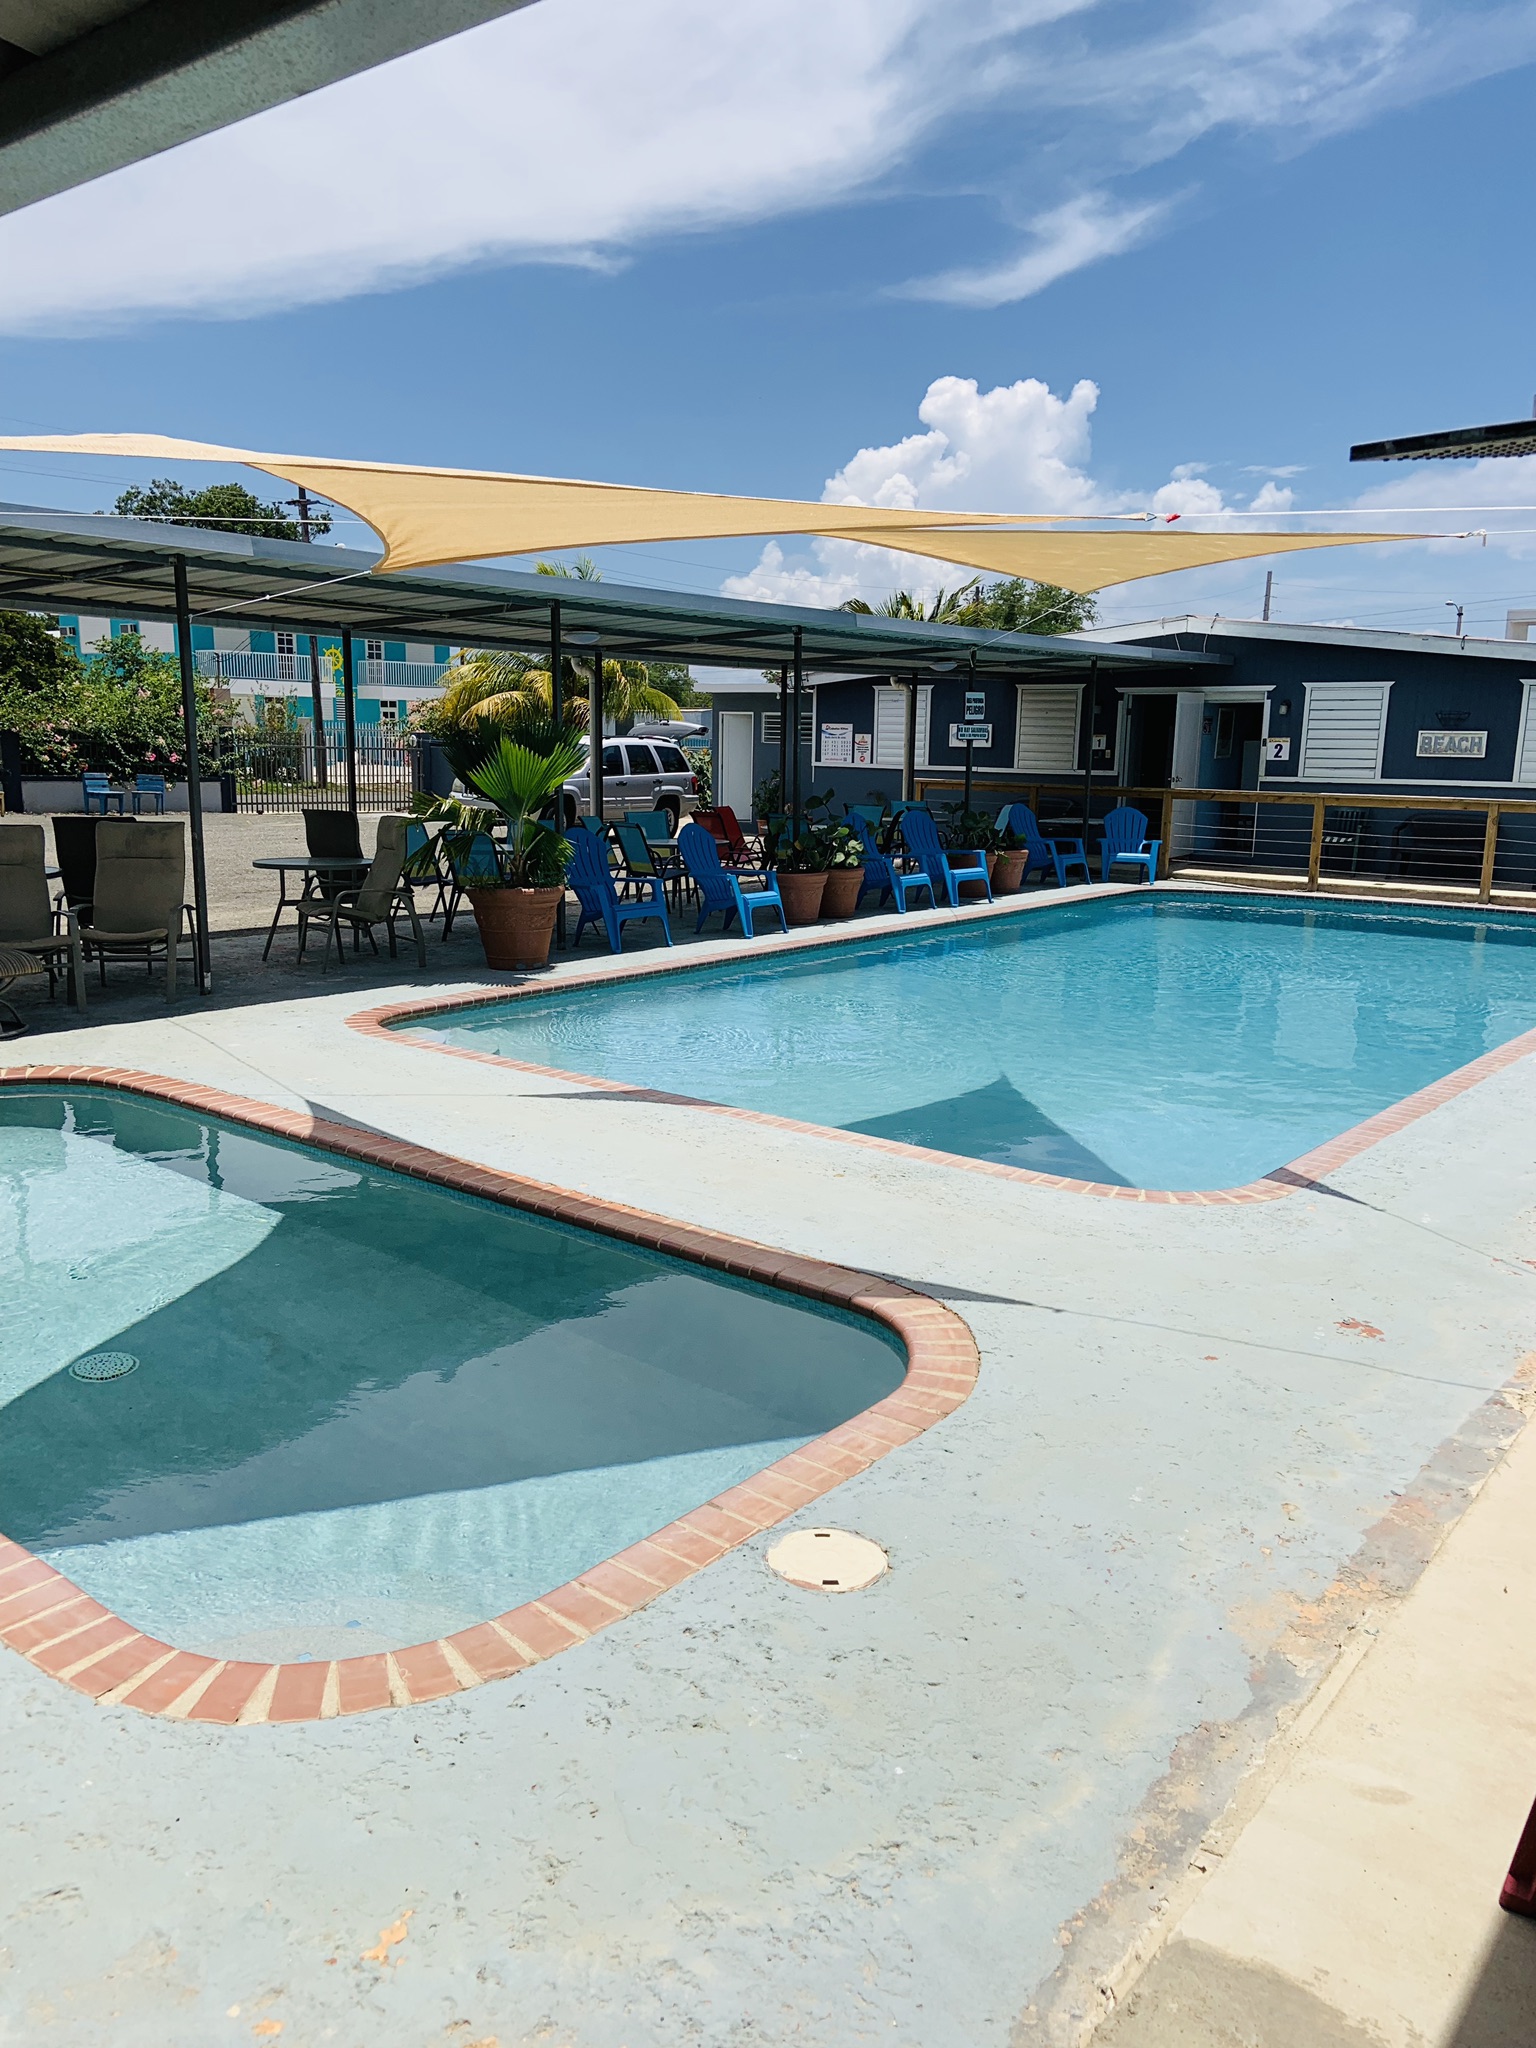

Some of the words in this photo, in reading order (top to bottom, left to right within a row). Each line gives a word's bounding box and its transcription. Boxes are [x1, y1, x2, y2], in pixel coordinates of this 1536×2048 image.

[965, 705, 984, 715] PELIGRO
[1097, 738, 1101, 748] 1
[1420, 735, 1483, 754] BEACH
[1273, 743, 1284, 758] 2
